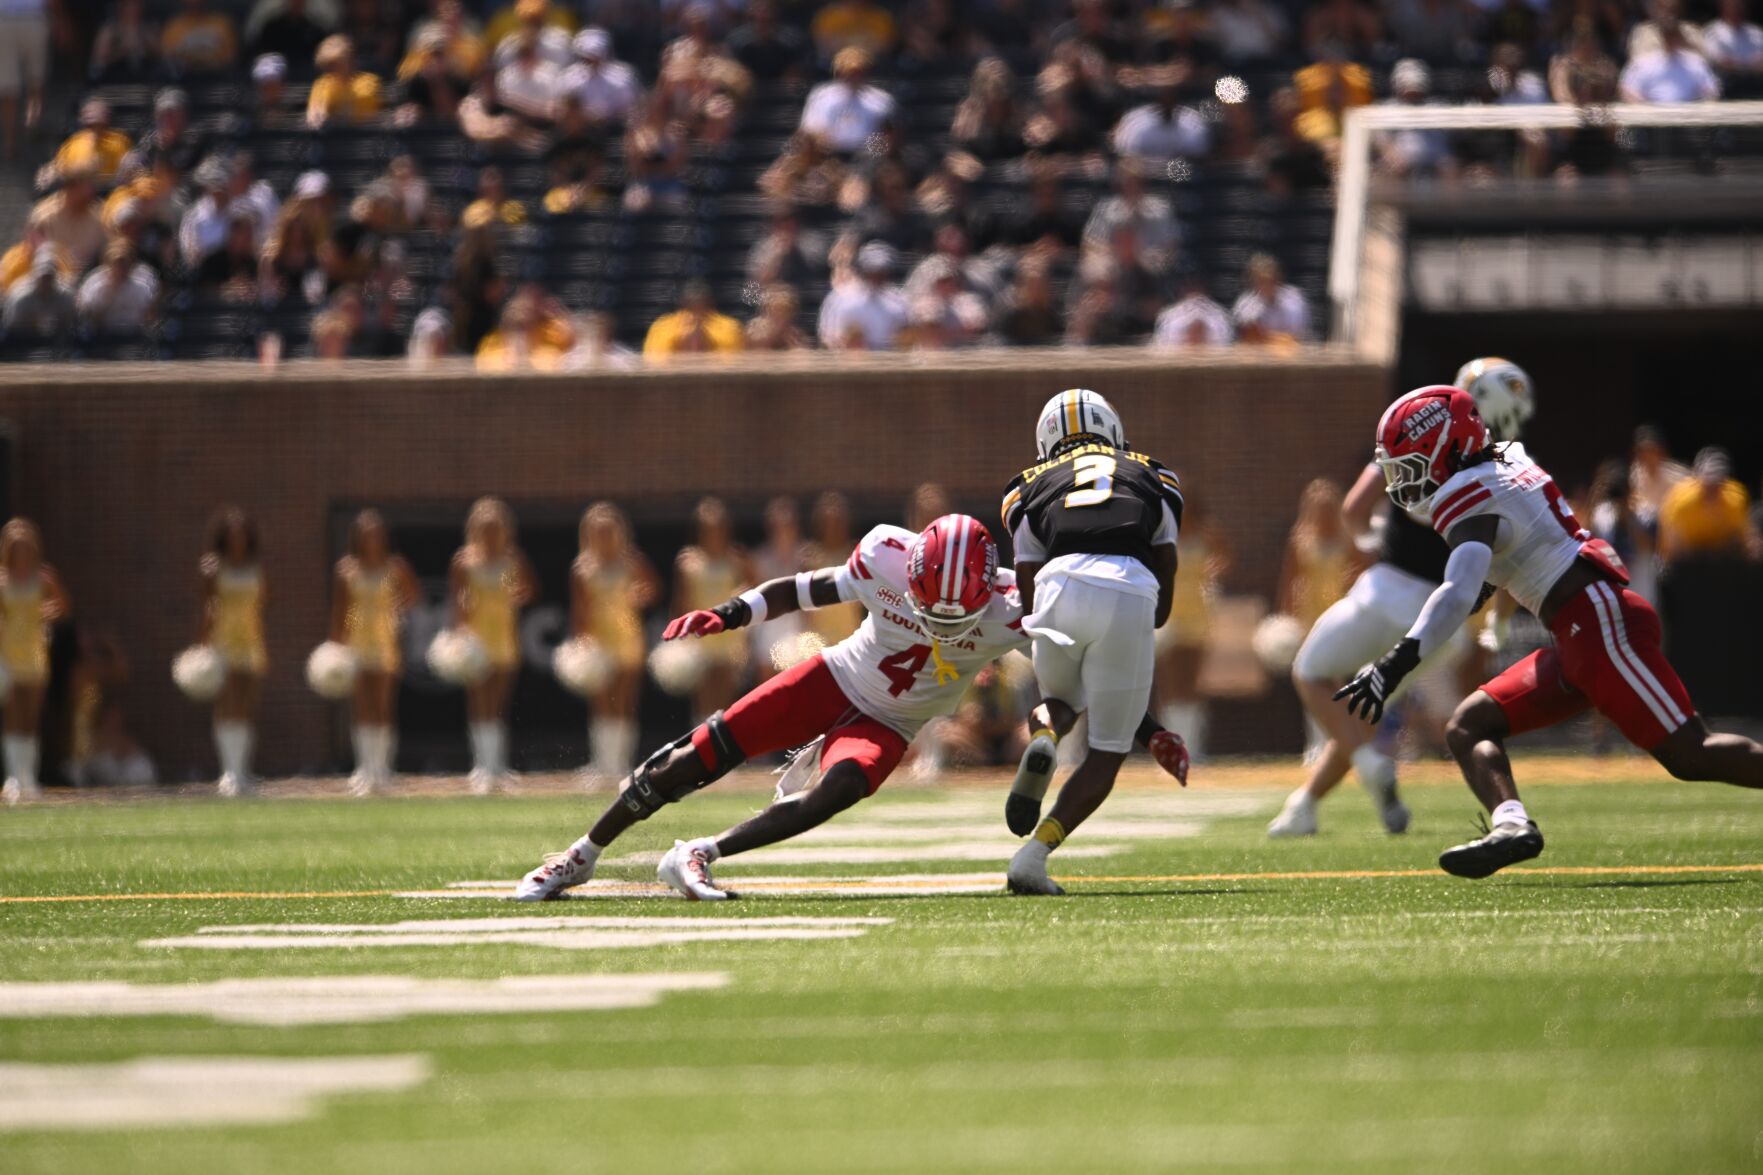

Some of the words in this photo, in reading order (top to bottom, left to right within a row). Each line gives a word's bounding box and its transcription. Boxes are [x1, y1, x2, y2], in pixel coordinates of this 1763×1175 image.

[1405, 400, 1442, 428] RAGIN
[1408, 408, 1451, 441] CAJUNS
[1022, 443, 1115, 484] COLEMAN
[1065, 454, 1117, 508] 3
[880, 537, 907, 551] 4
[877, 642, 935, 699] 4
